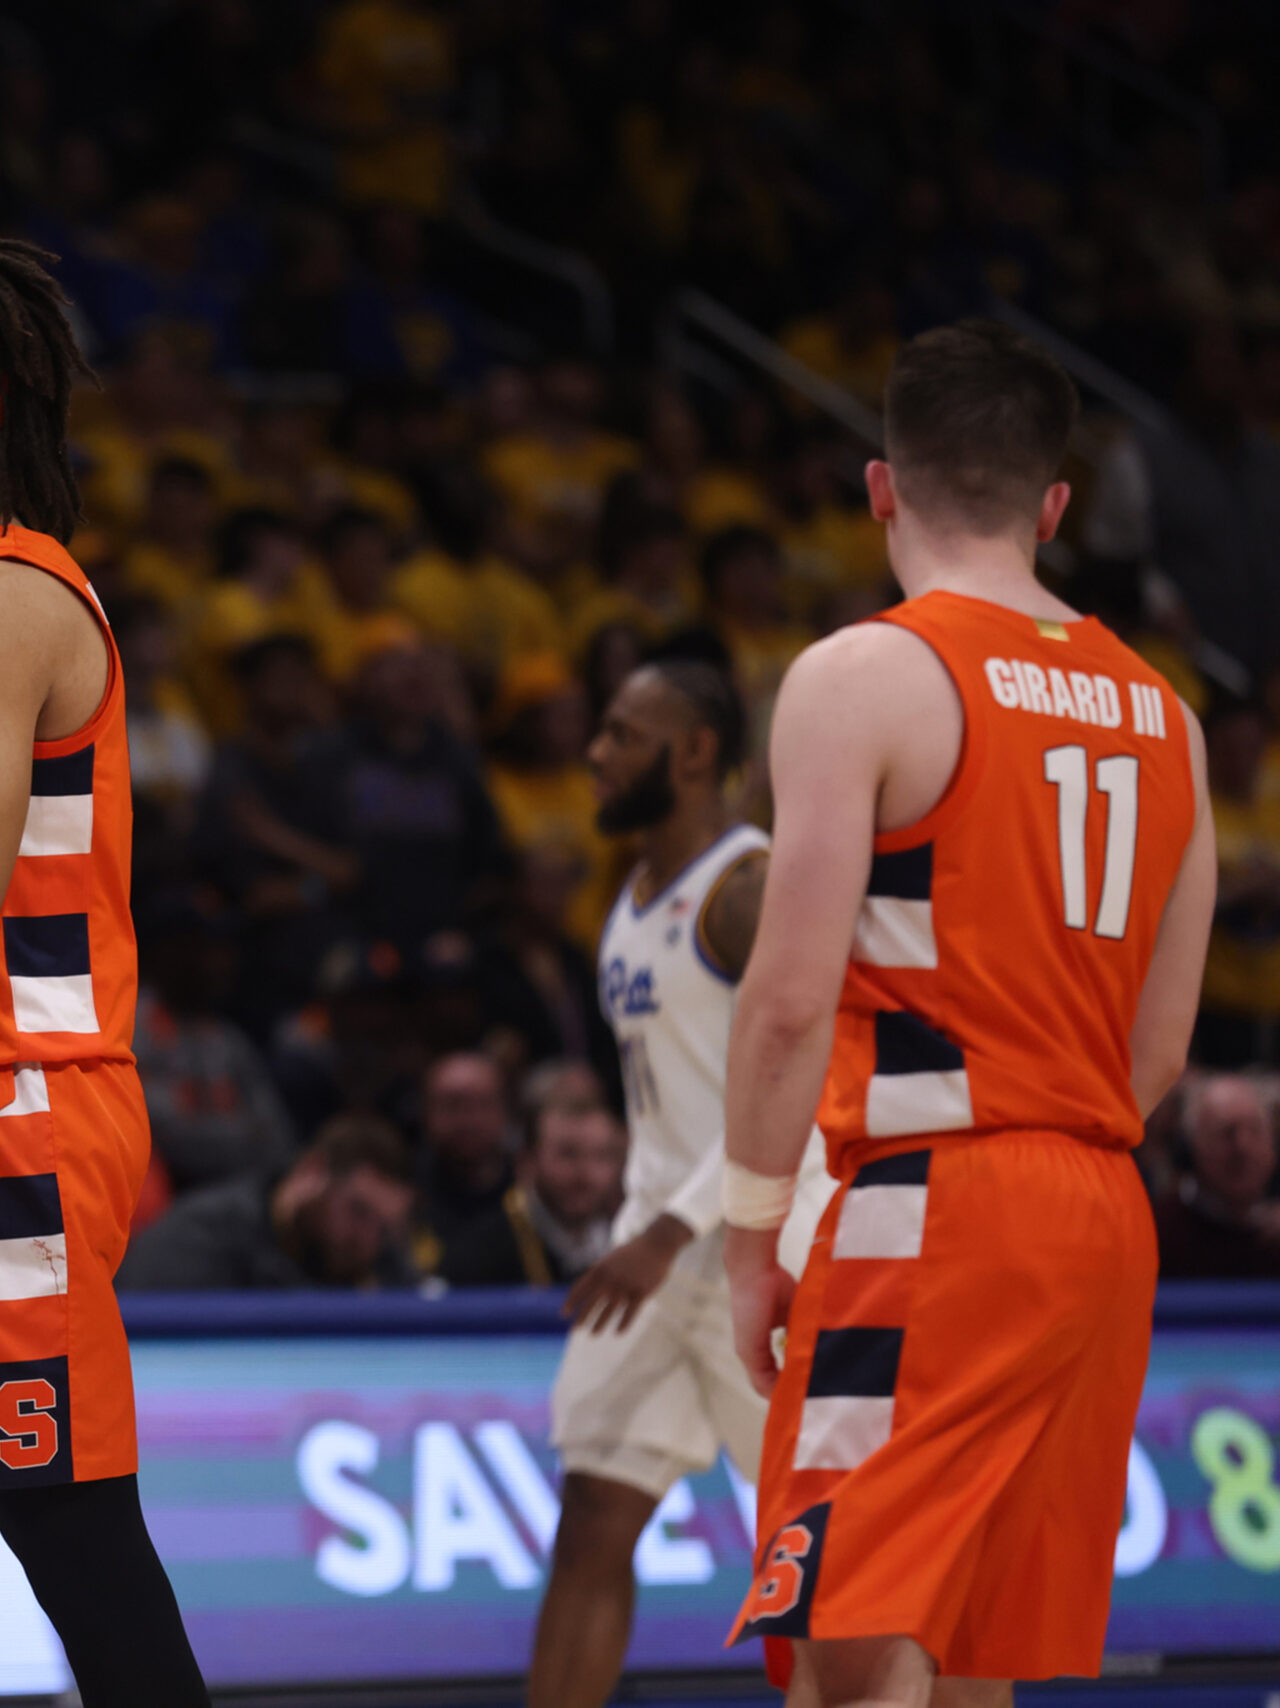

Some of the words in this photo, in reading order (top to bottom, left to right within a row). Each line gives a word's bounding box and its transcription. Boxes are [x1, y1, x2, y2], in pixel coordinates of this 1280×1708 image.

[983, 656, 1122, 729] GIRARD
[1128, 681, 1166, 740] III
[1043, 744, 1140, 940] 11
